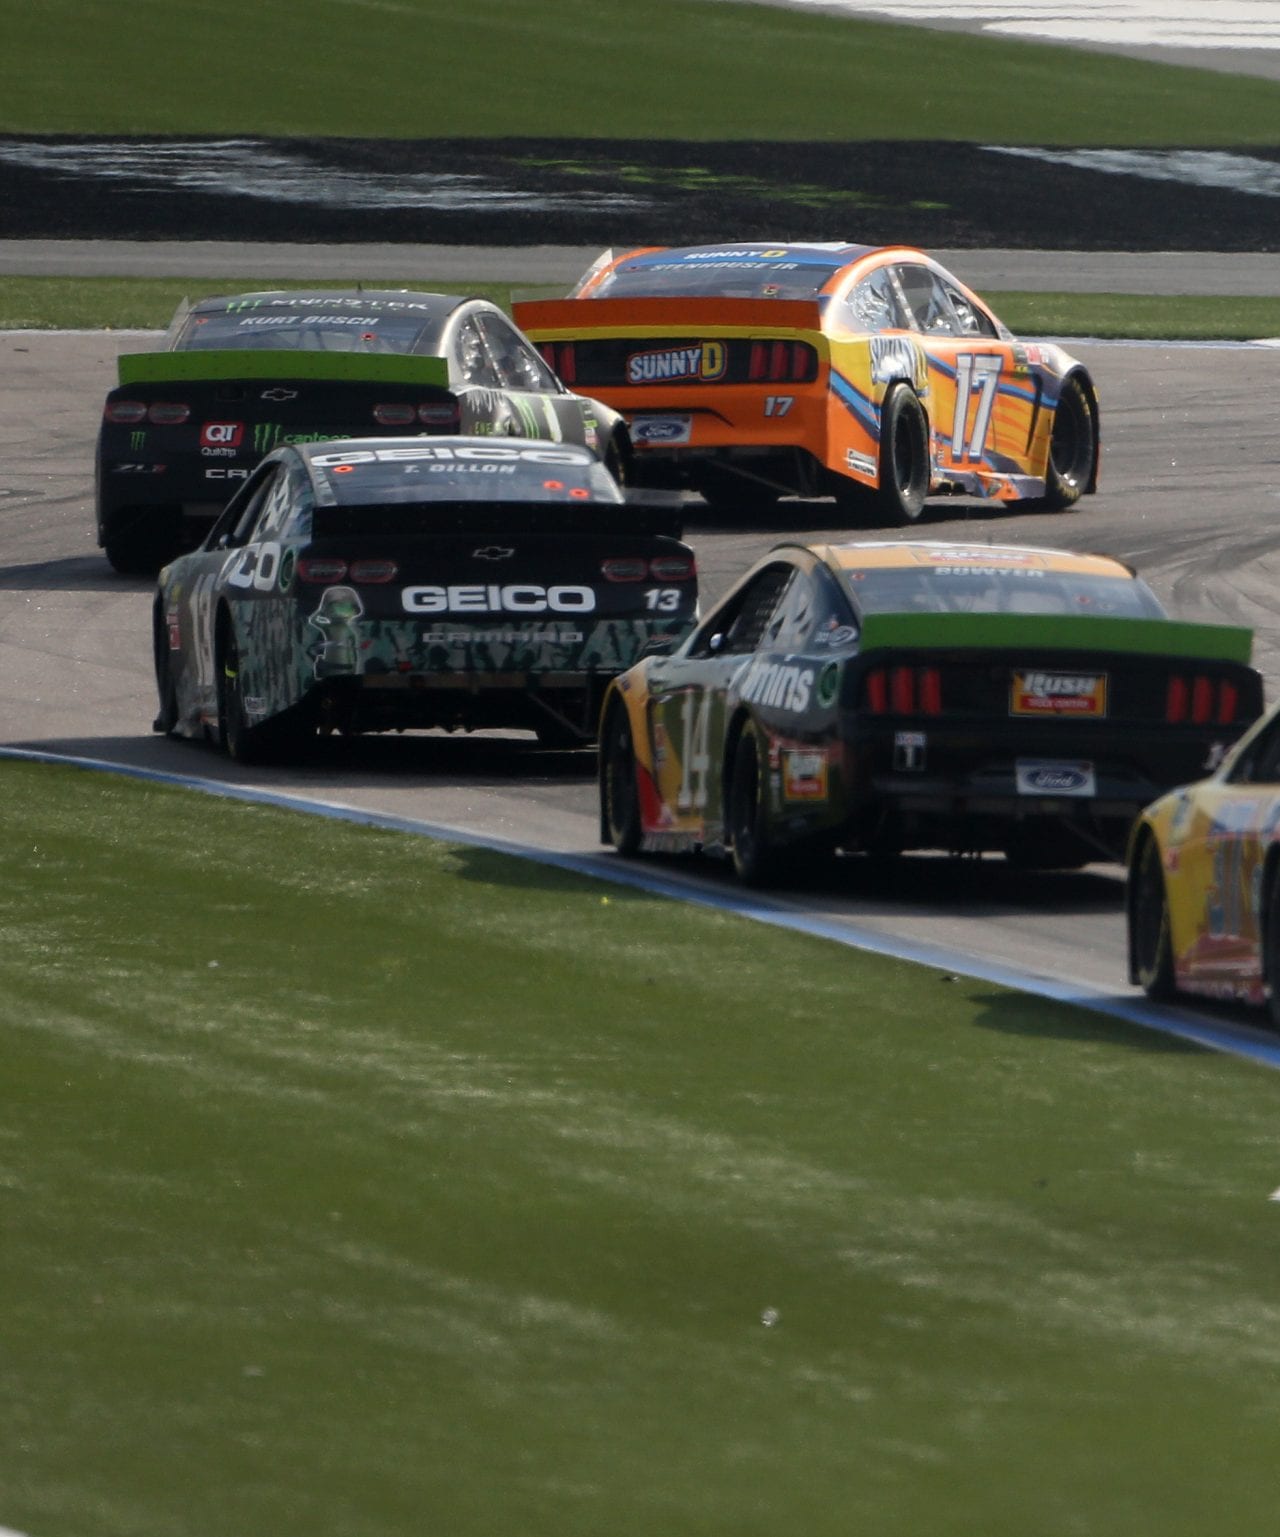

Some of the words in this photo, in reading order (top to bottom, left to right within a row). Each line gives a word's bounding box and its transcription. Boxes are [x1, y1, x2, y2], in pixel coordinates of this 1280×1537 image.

[240, 316, 296, 326] KURT
[301, 316, 379, 326] BUSCH
[630, 342, 724, 382] SUNNYD
[764, 396, 794, 416] 17
[951, 352, 1004, 463] 17
[206, 424, 237, 442] QT
[310, 447, 592, 467] GEICO
[404, 464, 420, 473] T.
[429, 463, 516, 475] DILLON
[401, 585, 597, 613] GEICO
[643, 589, 682, 611] 13
